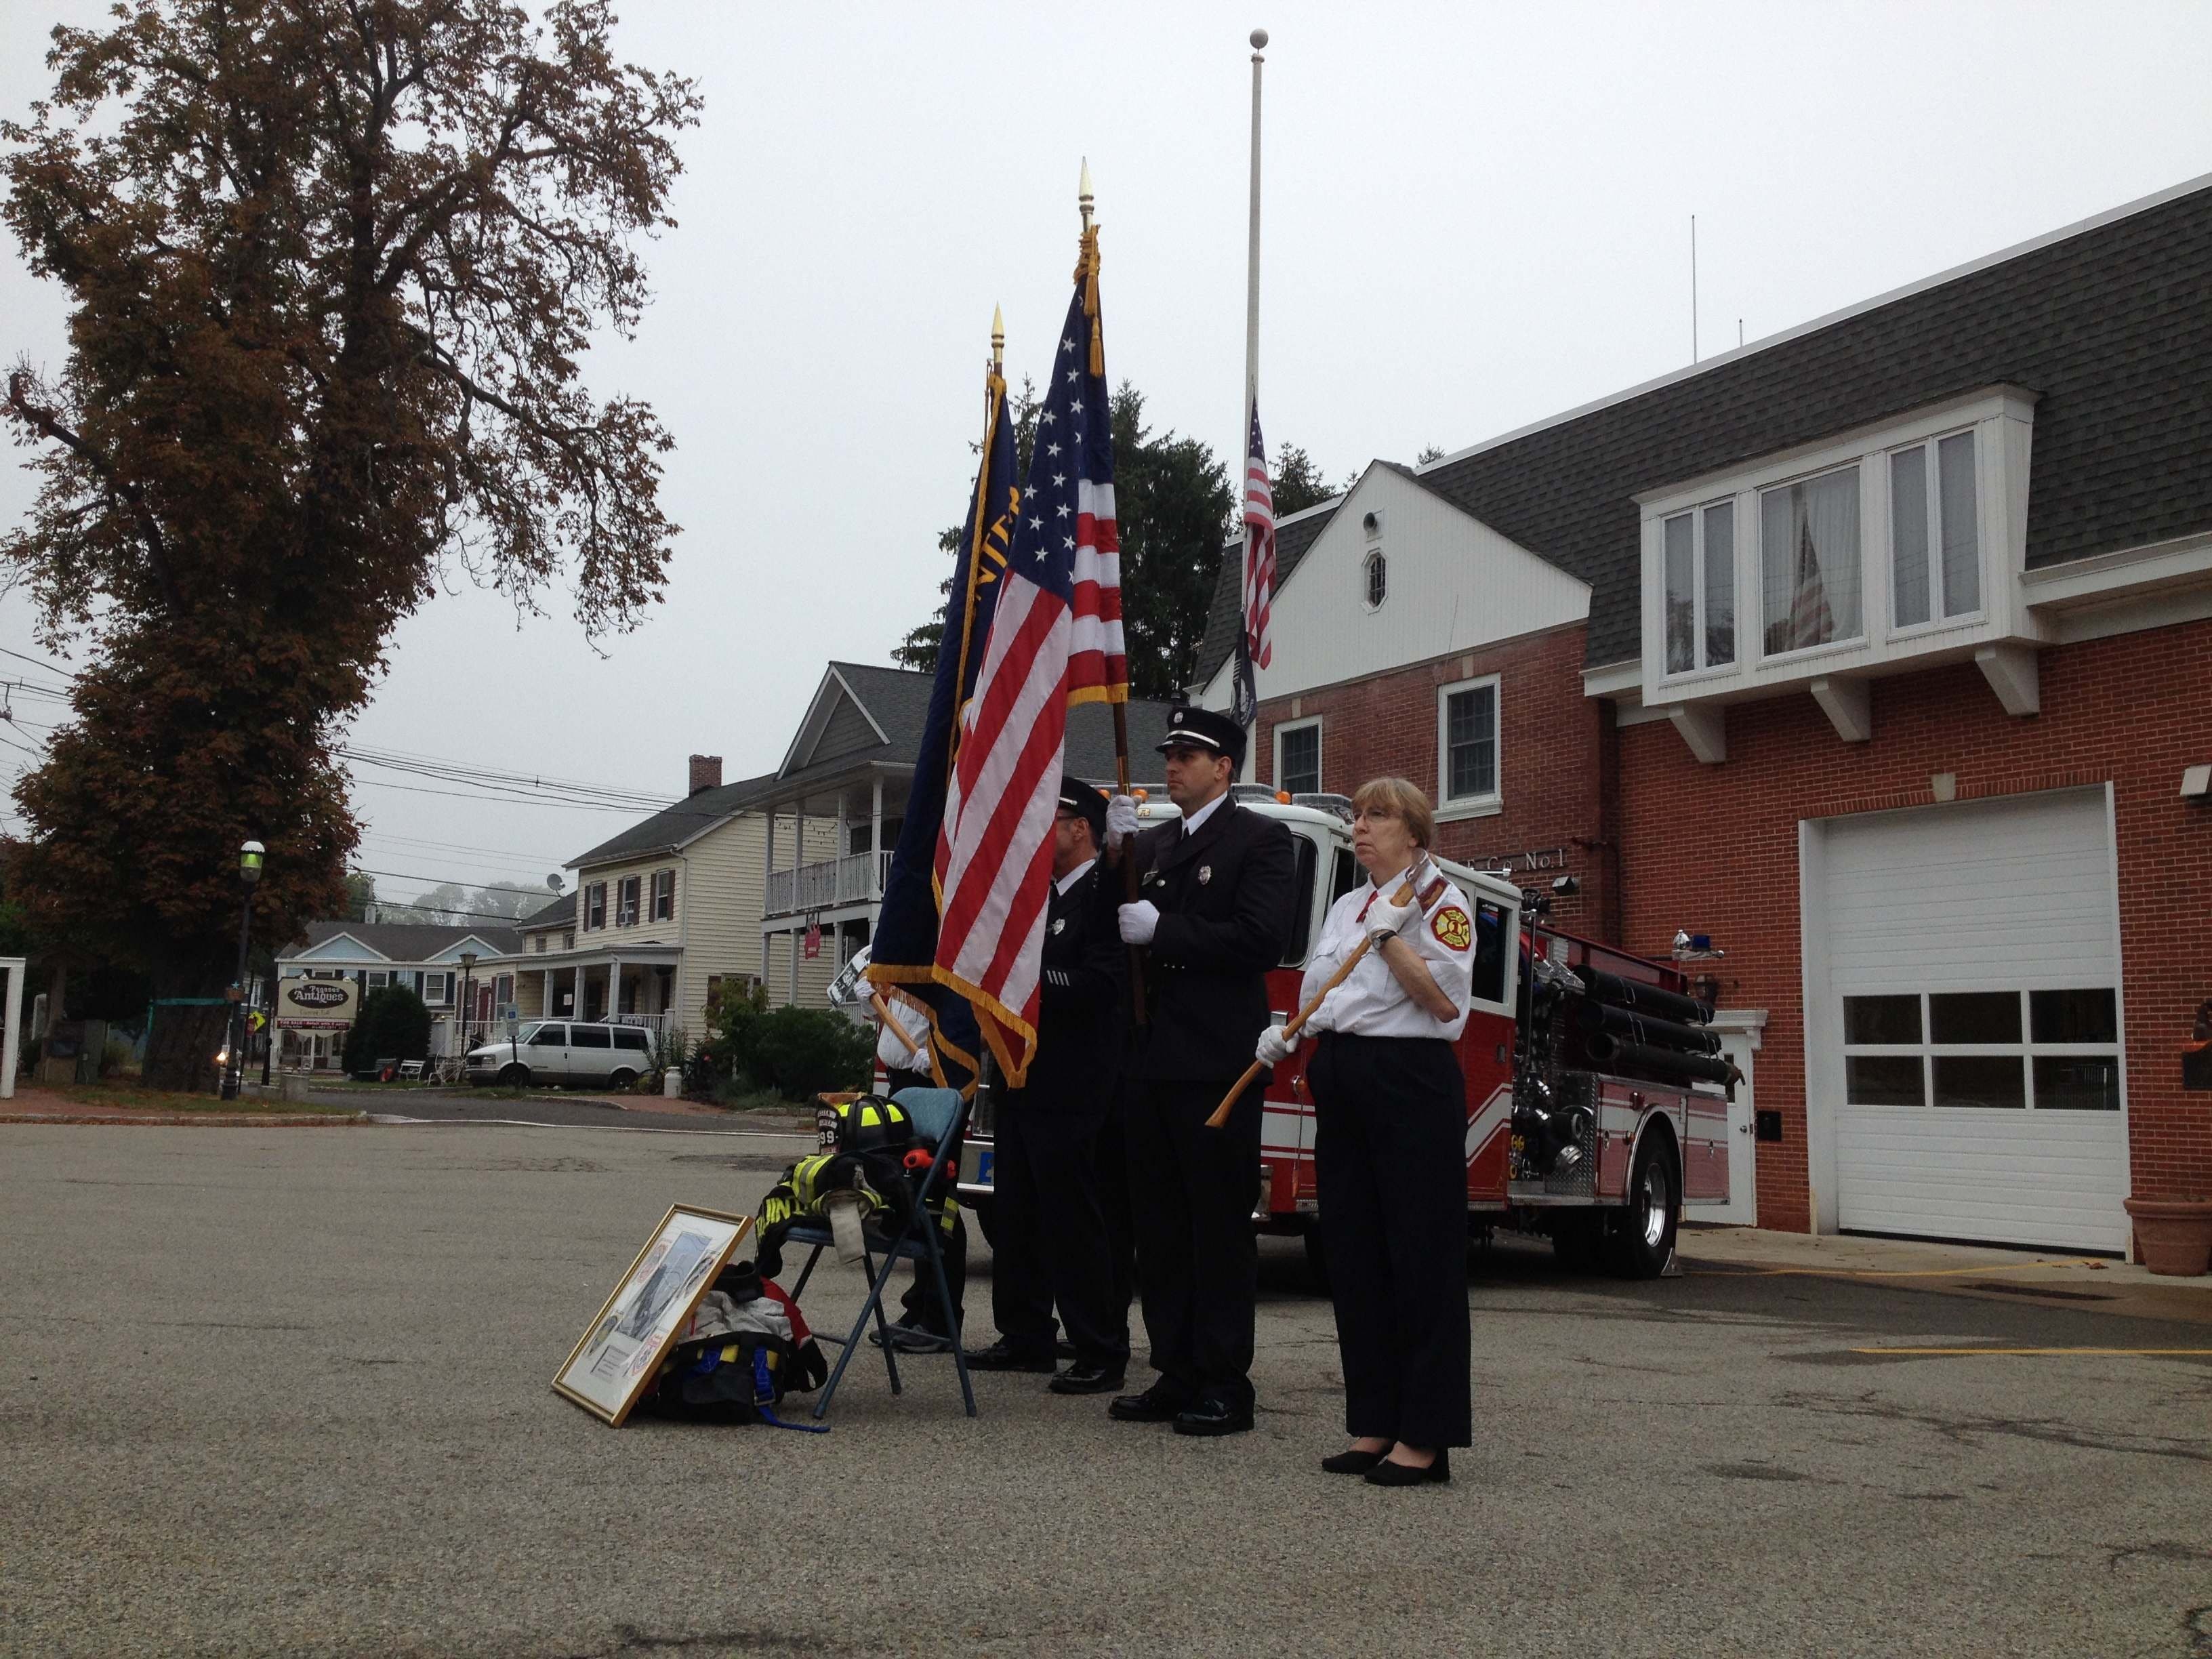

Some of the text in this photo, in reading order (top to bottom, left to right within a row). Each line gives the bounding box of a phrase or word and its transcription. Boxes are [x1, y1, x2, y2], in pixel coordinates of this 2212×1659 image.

[1452, 921, 1459, 935] 1
[294, 989, 344, 1004] Antiques
[819, 1130, 835, 1145] 99
